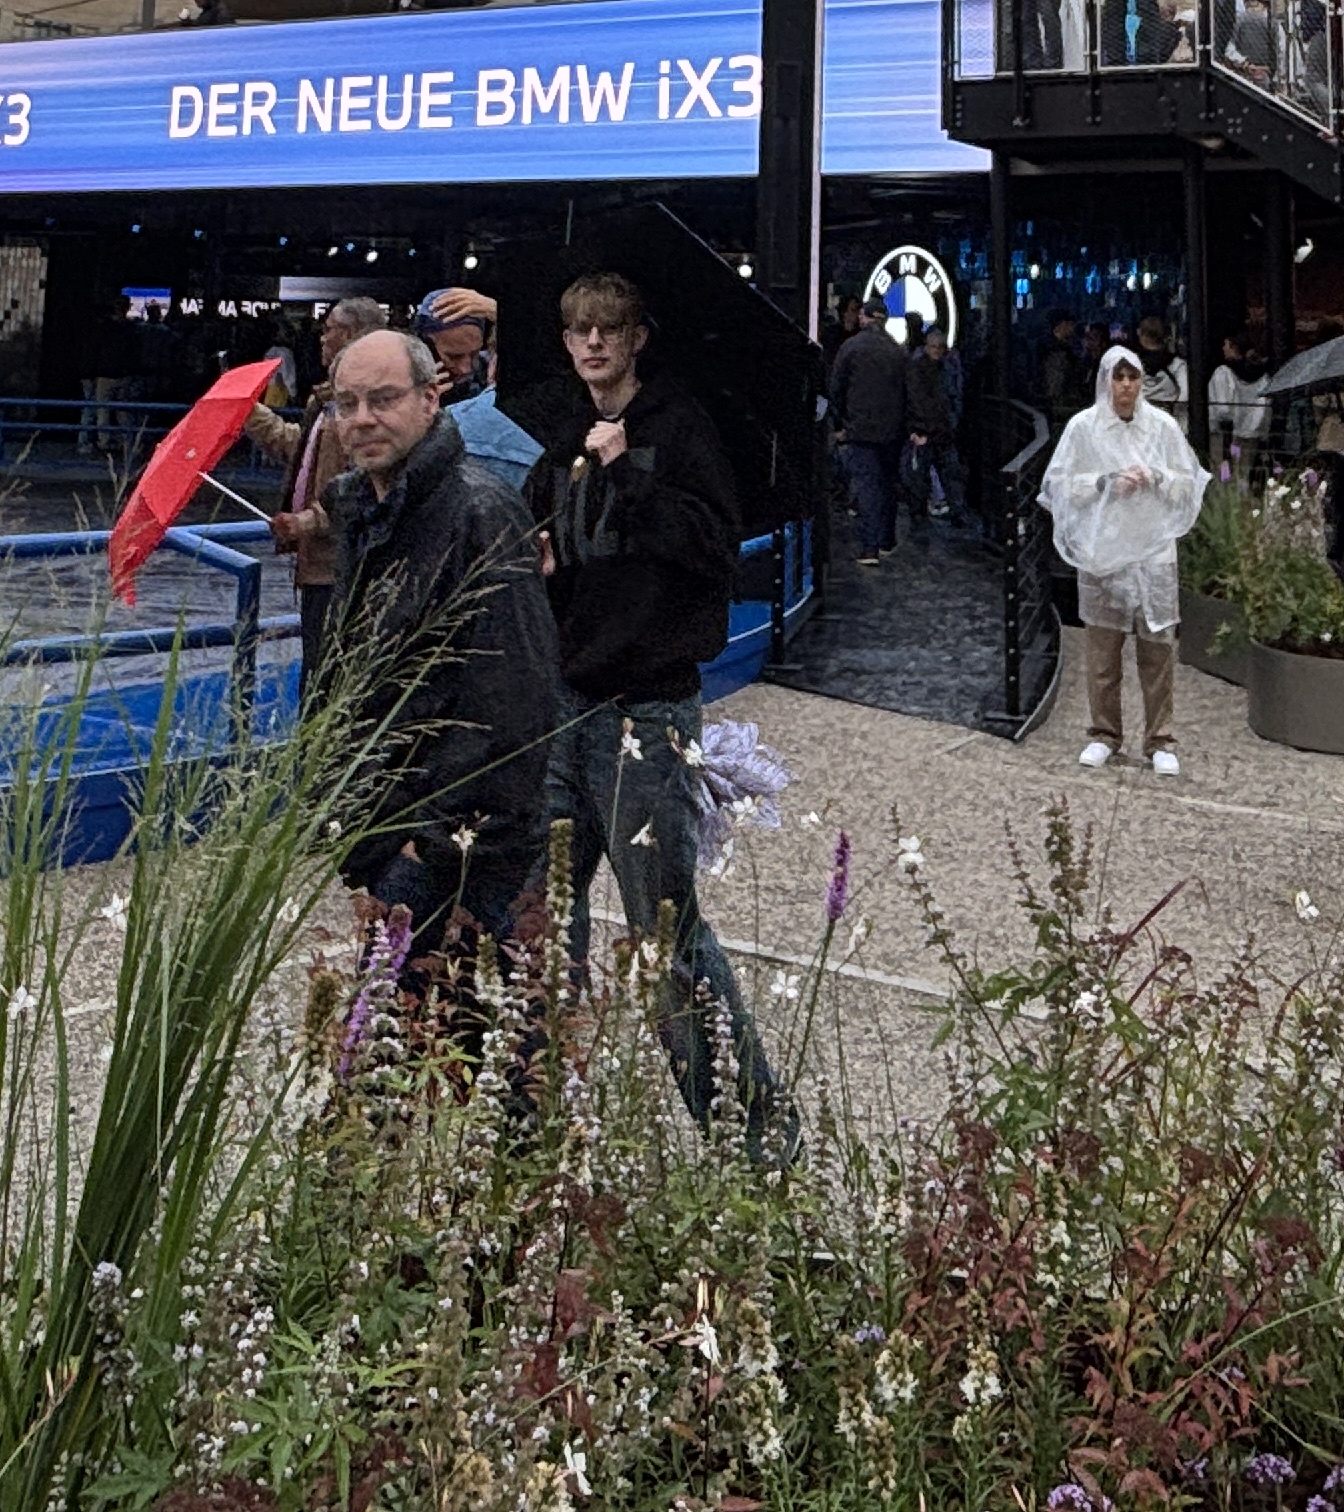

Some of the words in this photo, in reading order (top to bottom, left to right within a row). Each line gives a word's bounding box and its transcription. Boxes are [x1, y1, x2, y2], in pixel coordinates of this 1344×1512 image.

[168, 82, 277, 138] DER
[297, 72, 454, 133] NEUE
[476, 61, 635, 127] BMW
[657, 55, 764, 121] iX3
